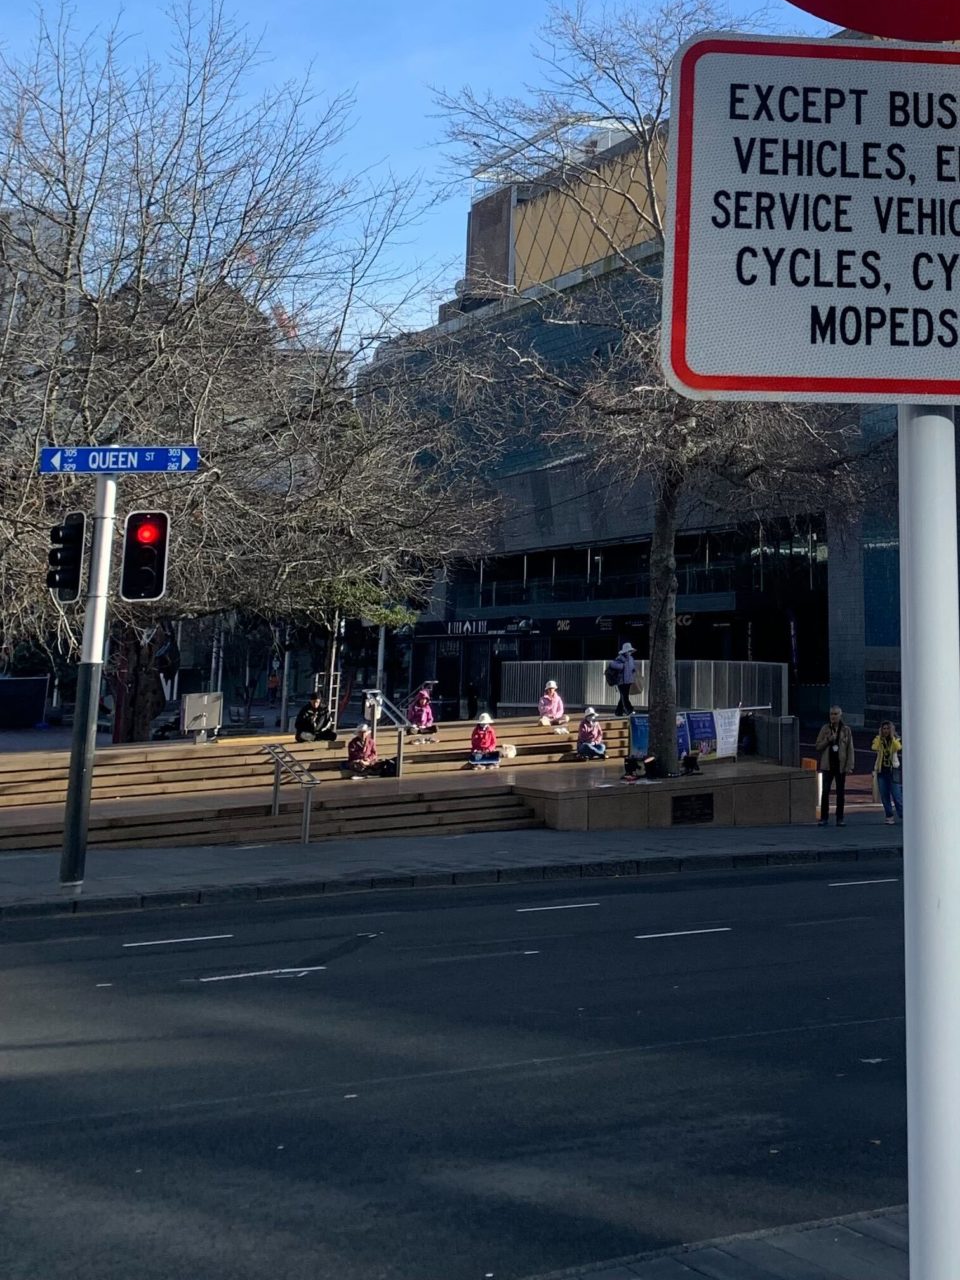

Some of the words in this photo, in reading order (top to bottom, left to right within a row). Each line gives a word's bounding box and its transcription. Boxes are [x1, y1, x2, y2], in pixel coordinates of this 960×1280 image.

[729, 82, 869, 126] EXCEPT
[732, 136, 917, 187] VEHICLES,
[711, 189, 853, 233] SERVICE
[735, 245, 892, 296] CYCLES,
[810, 305, 959, 349] MOPEDS
[64, 449, 77, 457] 305
[88, 452, 138, 469] QUEEN
[145, 452, 155, 461] ST
[168, 448, 181, 456] 303
